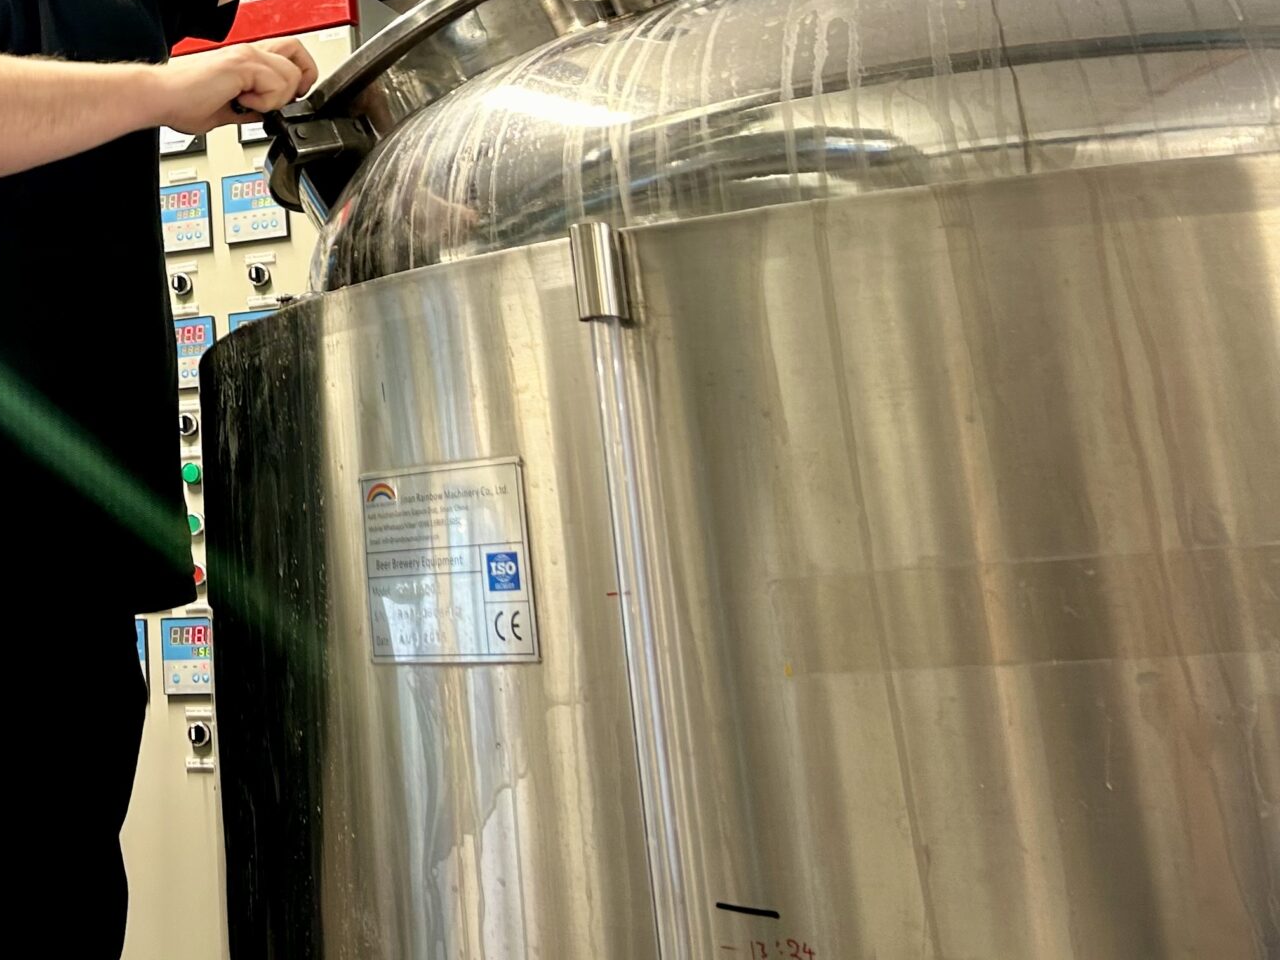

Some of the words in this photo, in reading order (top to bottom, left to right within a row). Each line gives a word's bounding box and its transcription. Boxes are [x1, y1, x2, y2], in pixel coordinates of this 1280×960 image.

[416, 492, 443, 502] Rainbow
[444, 487, 479, 500] Machinery
[376, 559, 391, 571] Beer
[392, 558, 420, 571] Brewery
[421, 555, 464, 570] Equipment
[489, 561, 517, 576] ISO
[494, 611, 522, 641] CE
